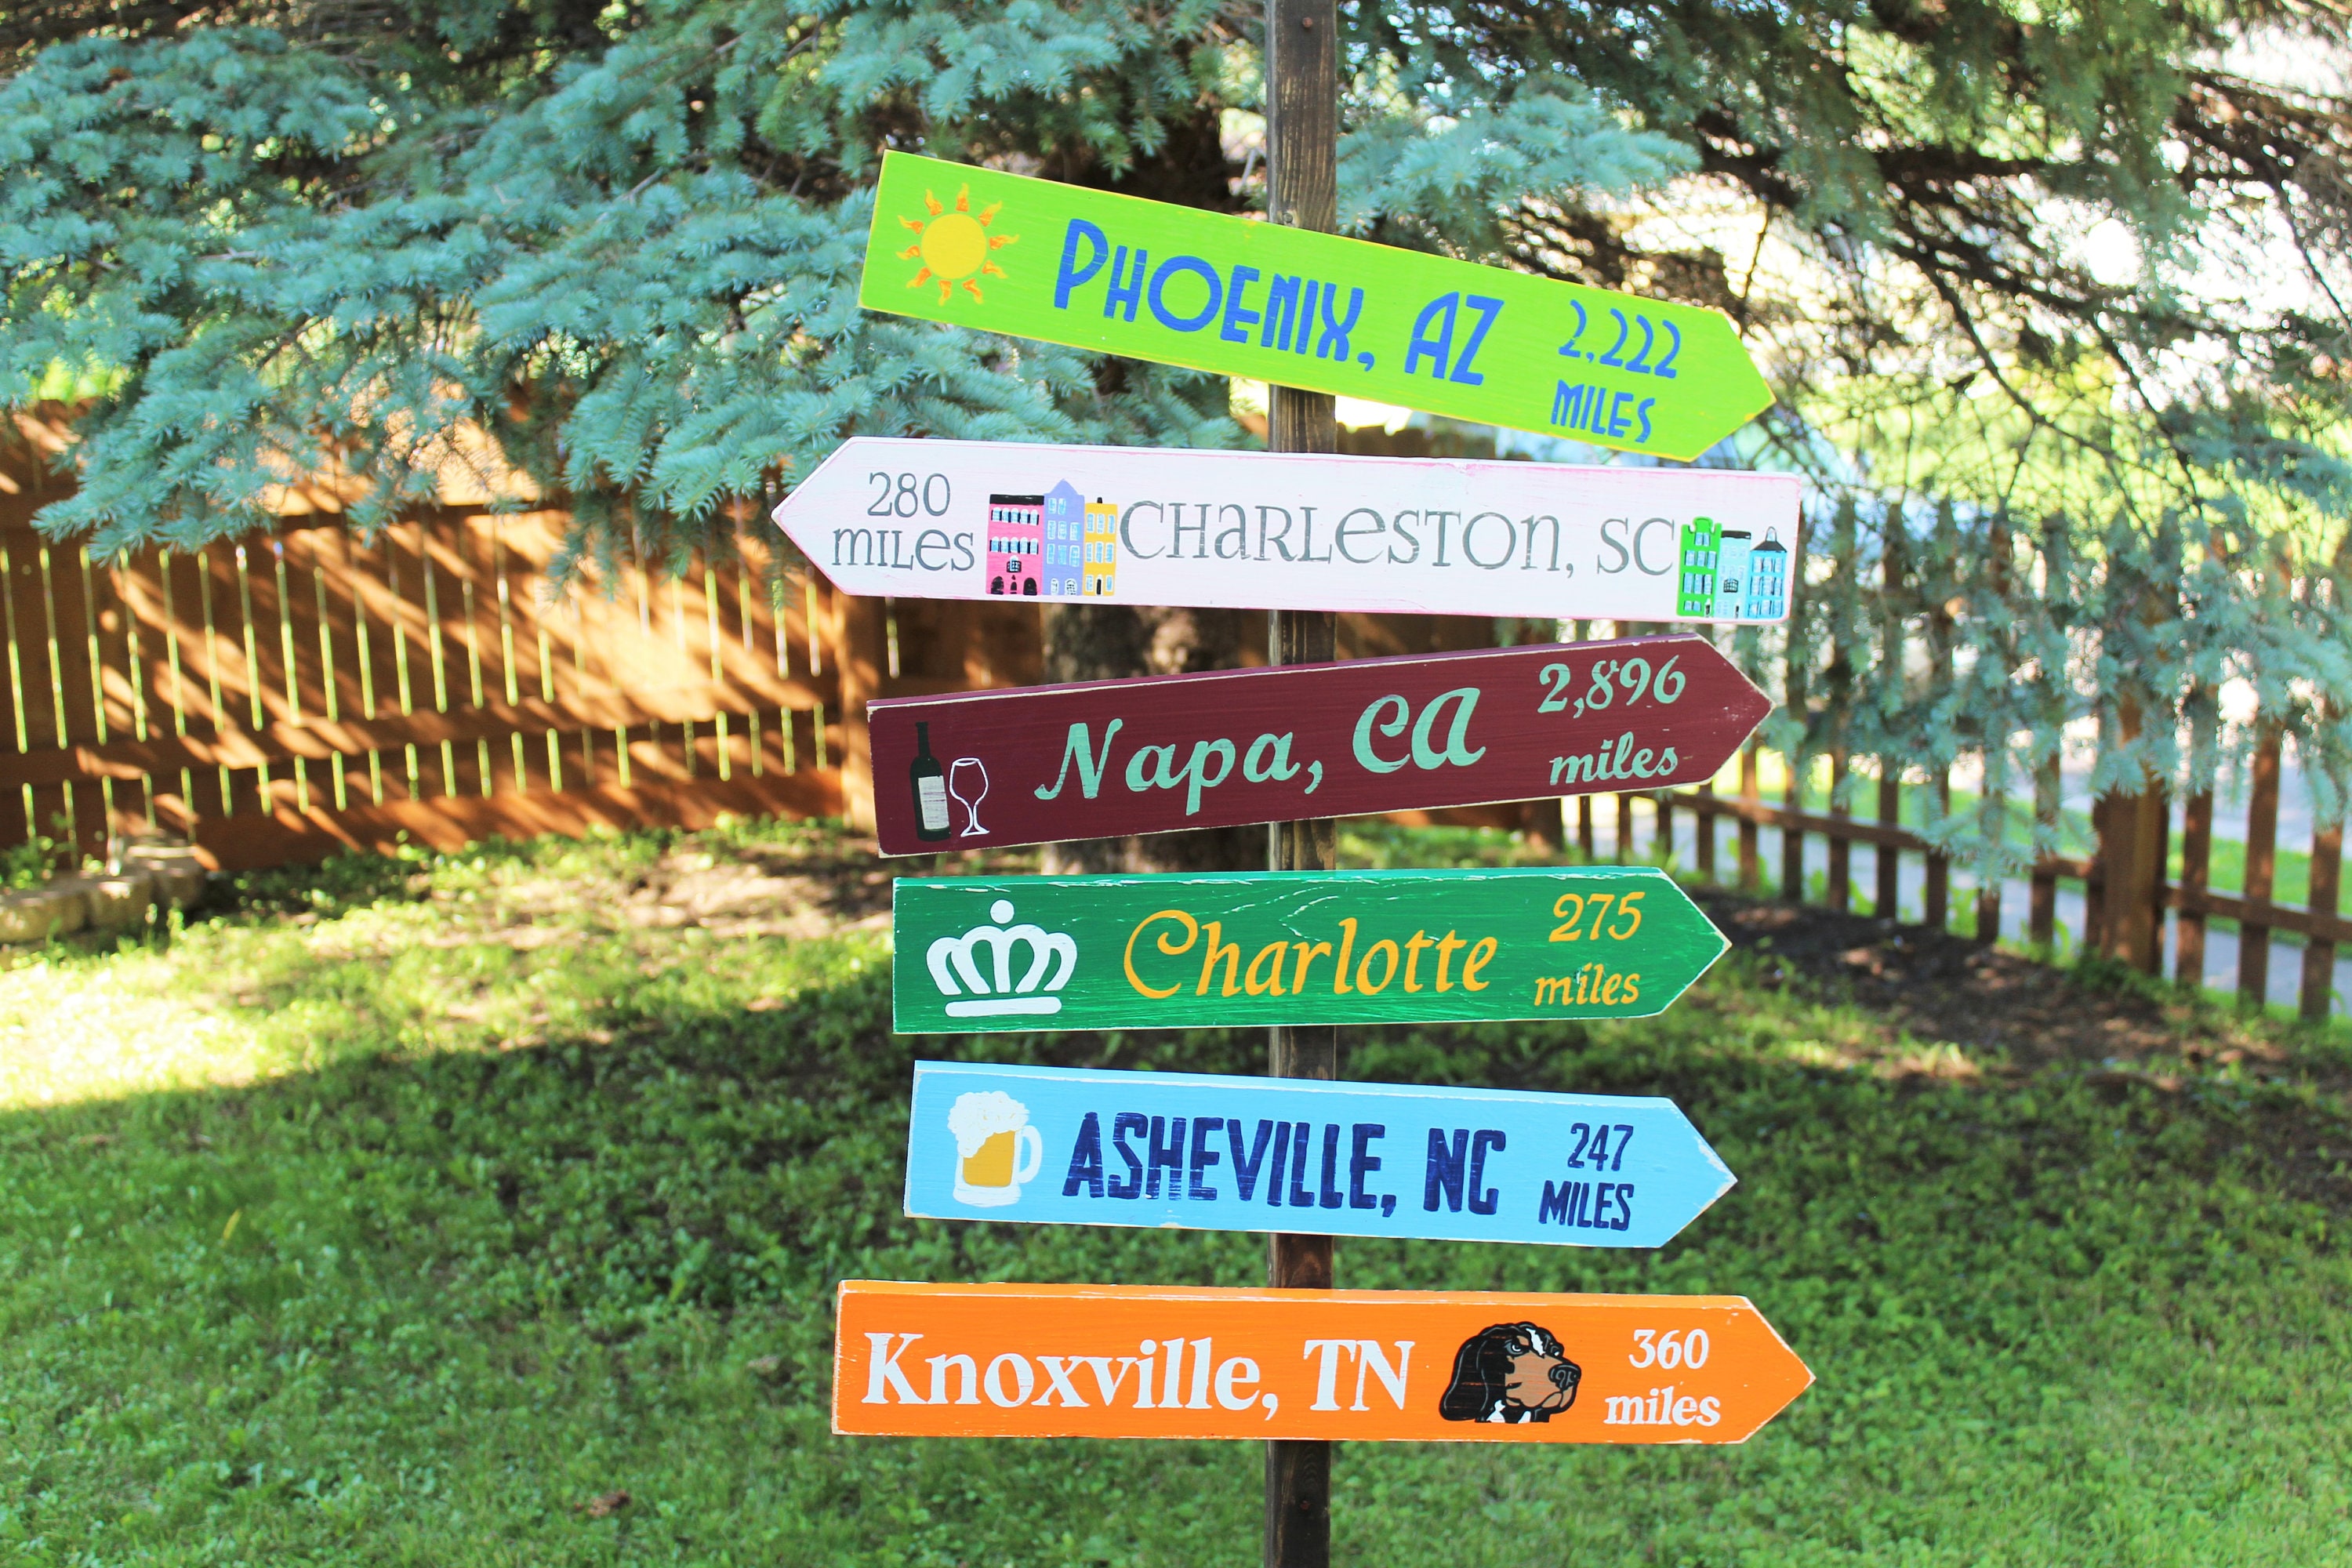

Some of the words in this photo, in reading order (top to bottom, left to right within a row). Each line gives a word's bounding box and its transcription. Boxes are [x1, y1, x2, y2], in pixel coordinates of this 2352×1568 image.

[1055, 220, 1374, 371] PHOENIX,
[1405, 292, 1504, 385] AZ
[1559, 299, 1680, 379] 2,222
[1551, 379, 1654, 443] MILES
[868, 472, 950, 517] 280
[1598, 518, 1674, 575] SC
[1538, 655, 1685, 719] 2,896
[1035, 719, 1322, 815] Napa,
[1353, 688, 1485, 773] CA
[1551, 731, 1678, 785] miles
[1549, 892, 1645, 942] 275
[1124, 910, 1497, 998] Charlotte
[1535, 964, 1639, 1005] miles
[1062, 1112, 1396, 1218] ASHEVILLE,
[1424, 1128, 1506, 1215] NC
[1568, 1123, 1633, 1171] 247
[1539, 1181, 1634, 1231] MILES
[862, 1333, 1278, 1420] Knoxville,
[1304, 1340, 1415, 1410] TN
[1629, 1329, 1709, 1369] 360
[1604, 1386, 1720, 1426] miles
